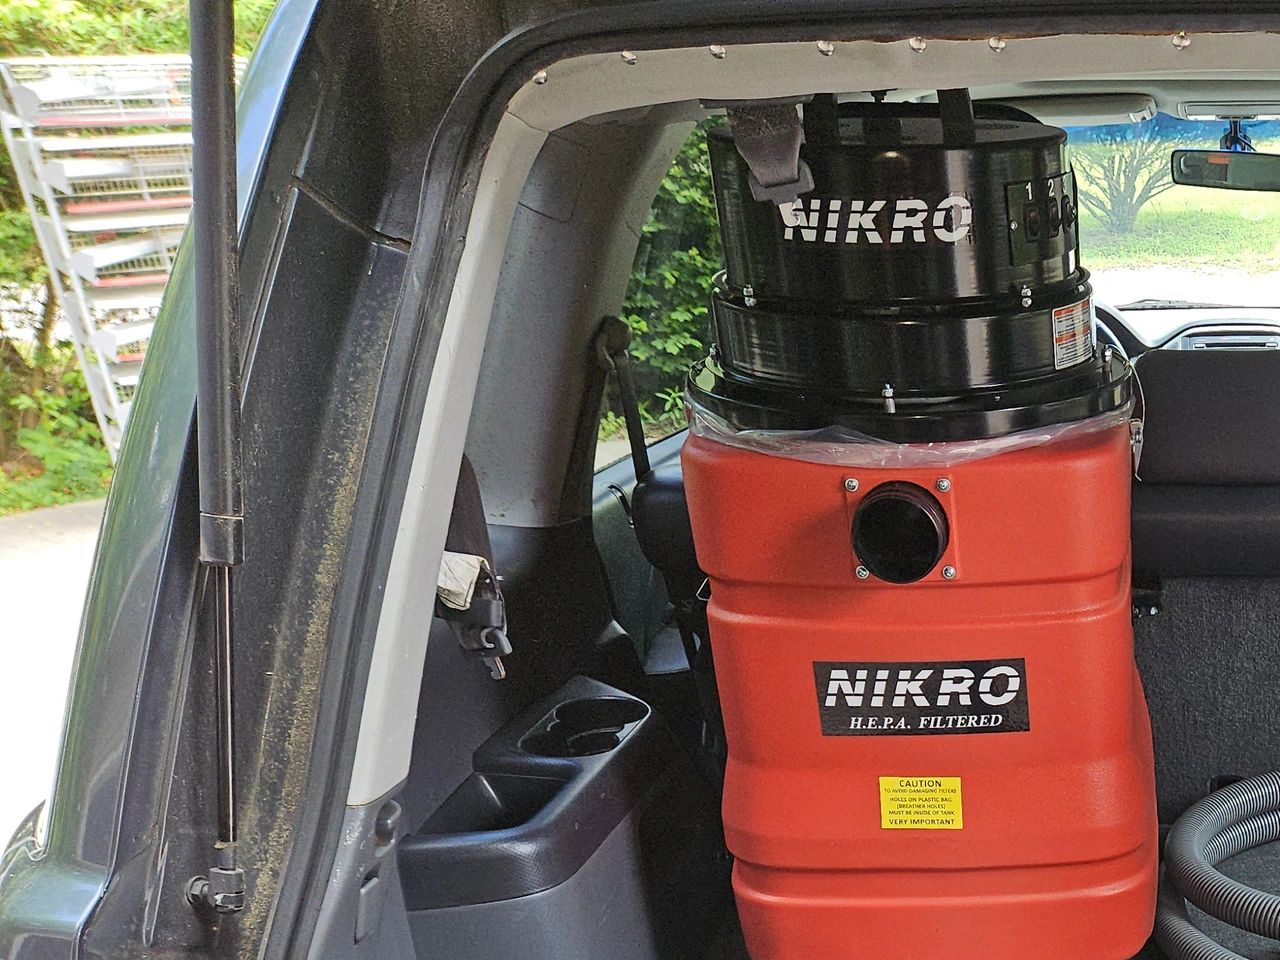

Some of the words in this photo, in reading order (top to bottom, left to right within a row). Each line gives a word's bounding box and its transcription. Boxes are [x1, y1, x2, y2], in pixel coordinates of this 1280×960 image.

[1025, 182, 1033, 200] 1
[1047, 179, 1055, 197] 2
[778, 195, 973, 244] NIKRO
[824, 665, 1021, 707] NIKRO
[849, 716, 911, 729] H.E.P.A.
[918, 714, 1003, 729] FILTERED
[899, 780, 942, 788] CAUTION
